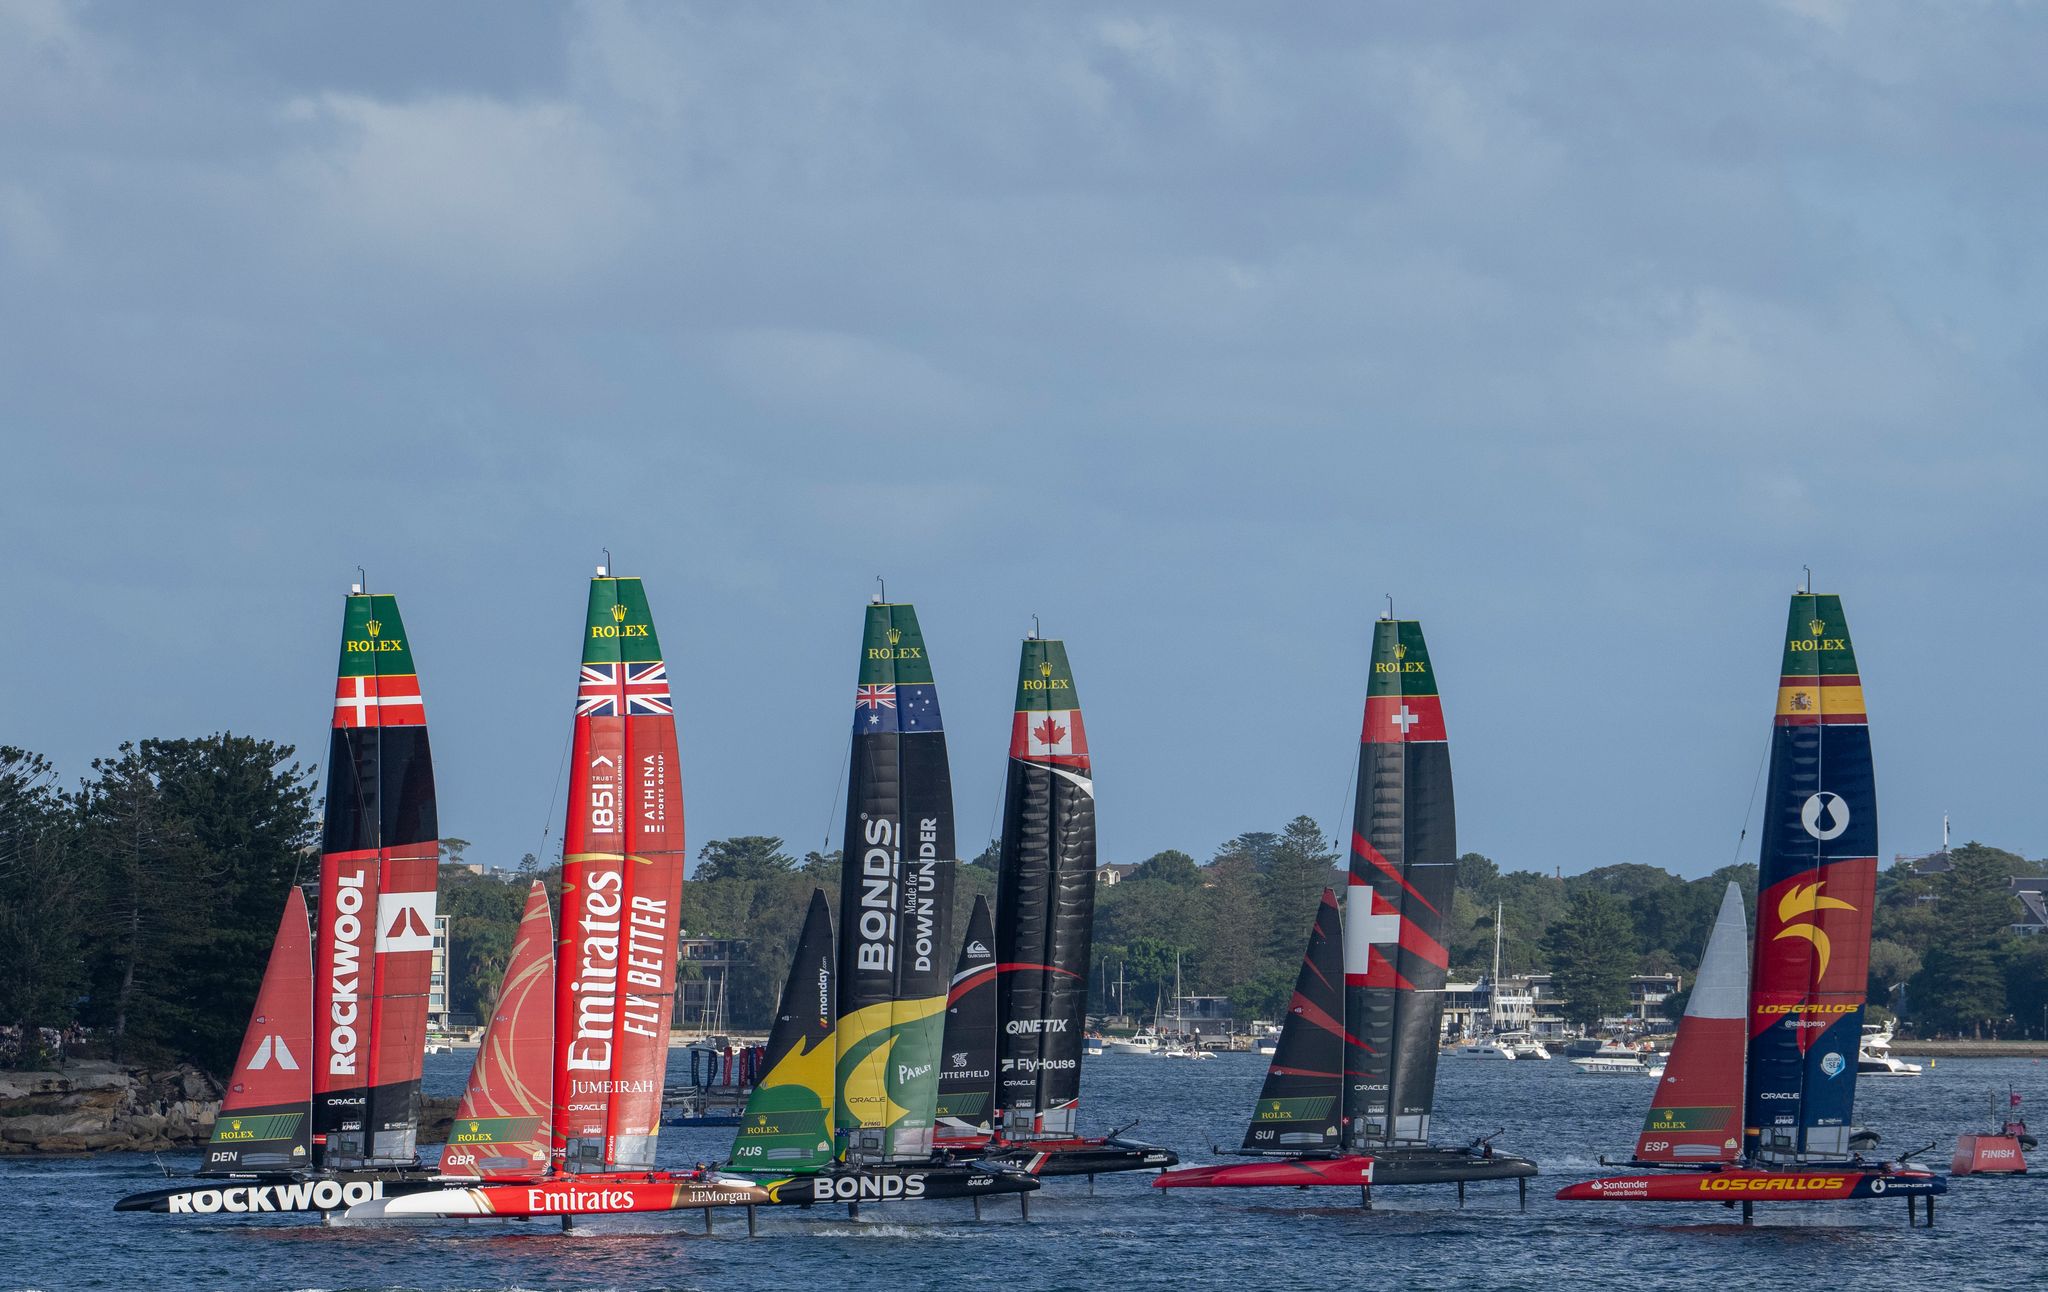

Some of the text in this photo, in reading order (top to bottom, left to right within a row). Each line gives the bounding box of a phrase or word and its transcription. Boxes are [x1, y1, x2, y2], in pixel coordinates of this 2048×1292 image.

[591, 624, 649, 638] ROLEX
[346, 639, 403, 652] ROLEX
[1790, 639, 1846, 652] ROLEX
[868, 647, 922, 660] ROLEX
[1375, 661, 1426, 673] ROLEX
[1023, 679, 1070, 691] ROLEX
[643, 754, 655, 820] ATHENA
[591, 783, 614, 834] 1851
[904, 871, 918, 916] Made for
[914, 817, 937, 972] DOWN UNDER
[329, 869, 365, 1075] ROCKWOOL
[566, 870, 623, 1072] Emirates
[623, 895, 667, 1038] FLY BETTER
[817, 955, 830, 1015] monday.com
[1005, 1018, 1069, 1036] QINETIX
[1017, 1058, 1076, 1072] FlyHouse
[938, 1070, 990, 1080] UTTERFIELD
[570, 1079, 654, 1097] JUMEIRAH
[1760, 1092, 1800, 1100] ORACLE
[567, 1103, 608, 1111] ORACLE
[1261, 1111, 1293, 1119] ROLEX
[1774, 1117, 1794, 1125] KPMG
[341, 1122, 361, 1131] KPMG
[583, 1125, 602, 1134] KPMG
[747, 1126, 779, 1134] ROLEX
[1653, 1121, 1687, 1129] ROLEX
[220, 1130, 255, 1140] ROLEX
[457, 1133, 493, 1142] ROLEX
[1255, 1129, 1275, 1140] SUI
[736, 1146, 763, 1157] AUS
[1644, 1141, 1669, 1151] ESP
[211, 1151, 238, 1163] DEN
[447, 1154, 476, 1166] GBR
[1981, 1149, 2015, 1159] FINISH
[814, 1174, 926, 1199] BONDS
[967, 1178, 994, 1186] SAILGP
[1603, 1180, 1649, 1189] Santander
[527, 1186, 635, 1212] Emirates
[1623, 1189, 1648, 1197] Banking
